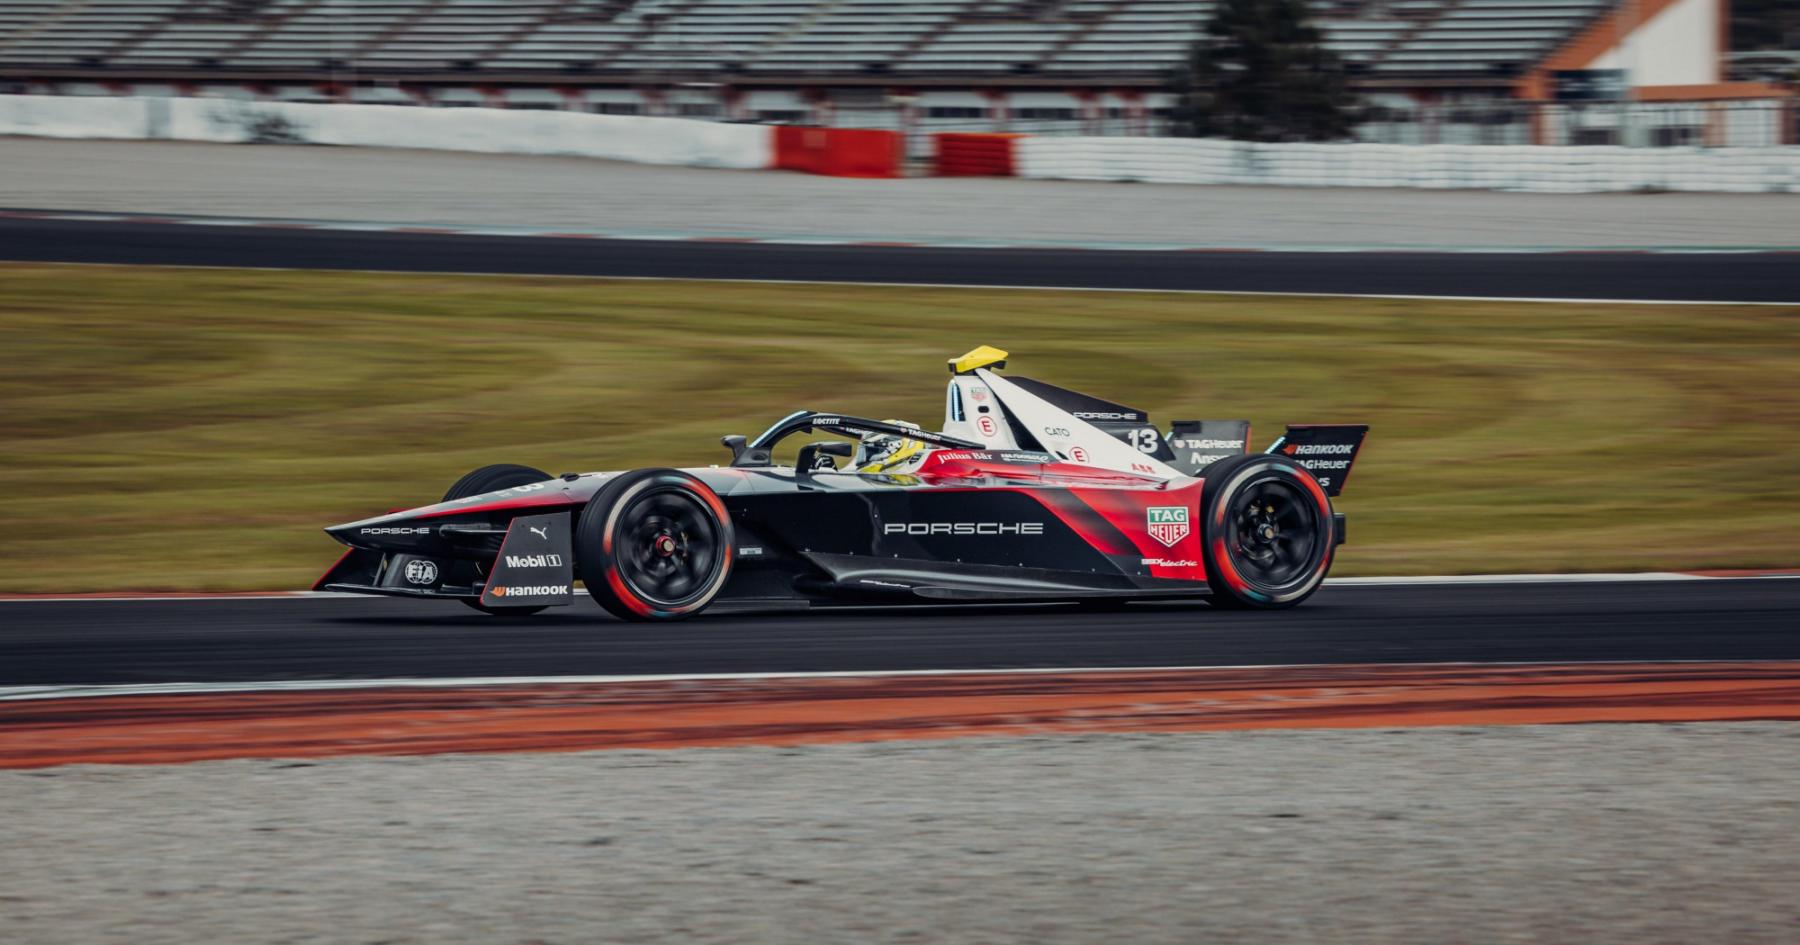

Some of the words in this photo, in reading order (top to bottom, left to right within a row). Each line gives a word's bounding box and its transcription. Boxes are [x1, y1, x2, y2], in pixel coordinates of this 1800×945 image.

[1073, 412, 1136, 420] PORSCHE
[981, 421, 992, 432] E
[1044, 426, 1071, 437] CATO
[1128, 428, 1158, 453] 13
[938, 453, 971, 464] Julius
[972, 452, 993, 460] Bär
[1074, 450, 1086, 462] E
[1151, 510, 1185, 521] TAG
[361, 527, 430, 535] PORSCHE
[884, 523, 1043, 535] PORSCHE
[1151, 525, 1186, 543] HEUER
[505, 555, 546, 568] Mobil
[549, 555, 560, 566] 1
